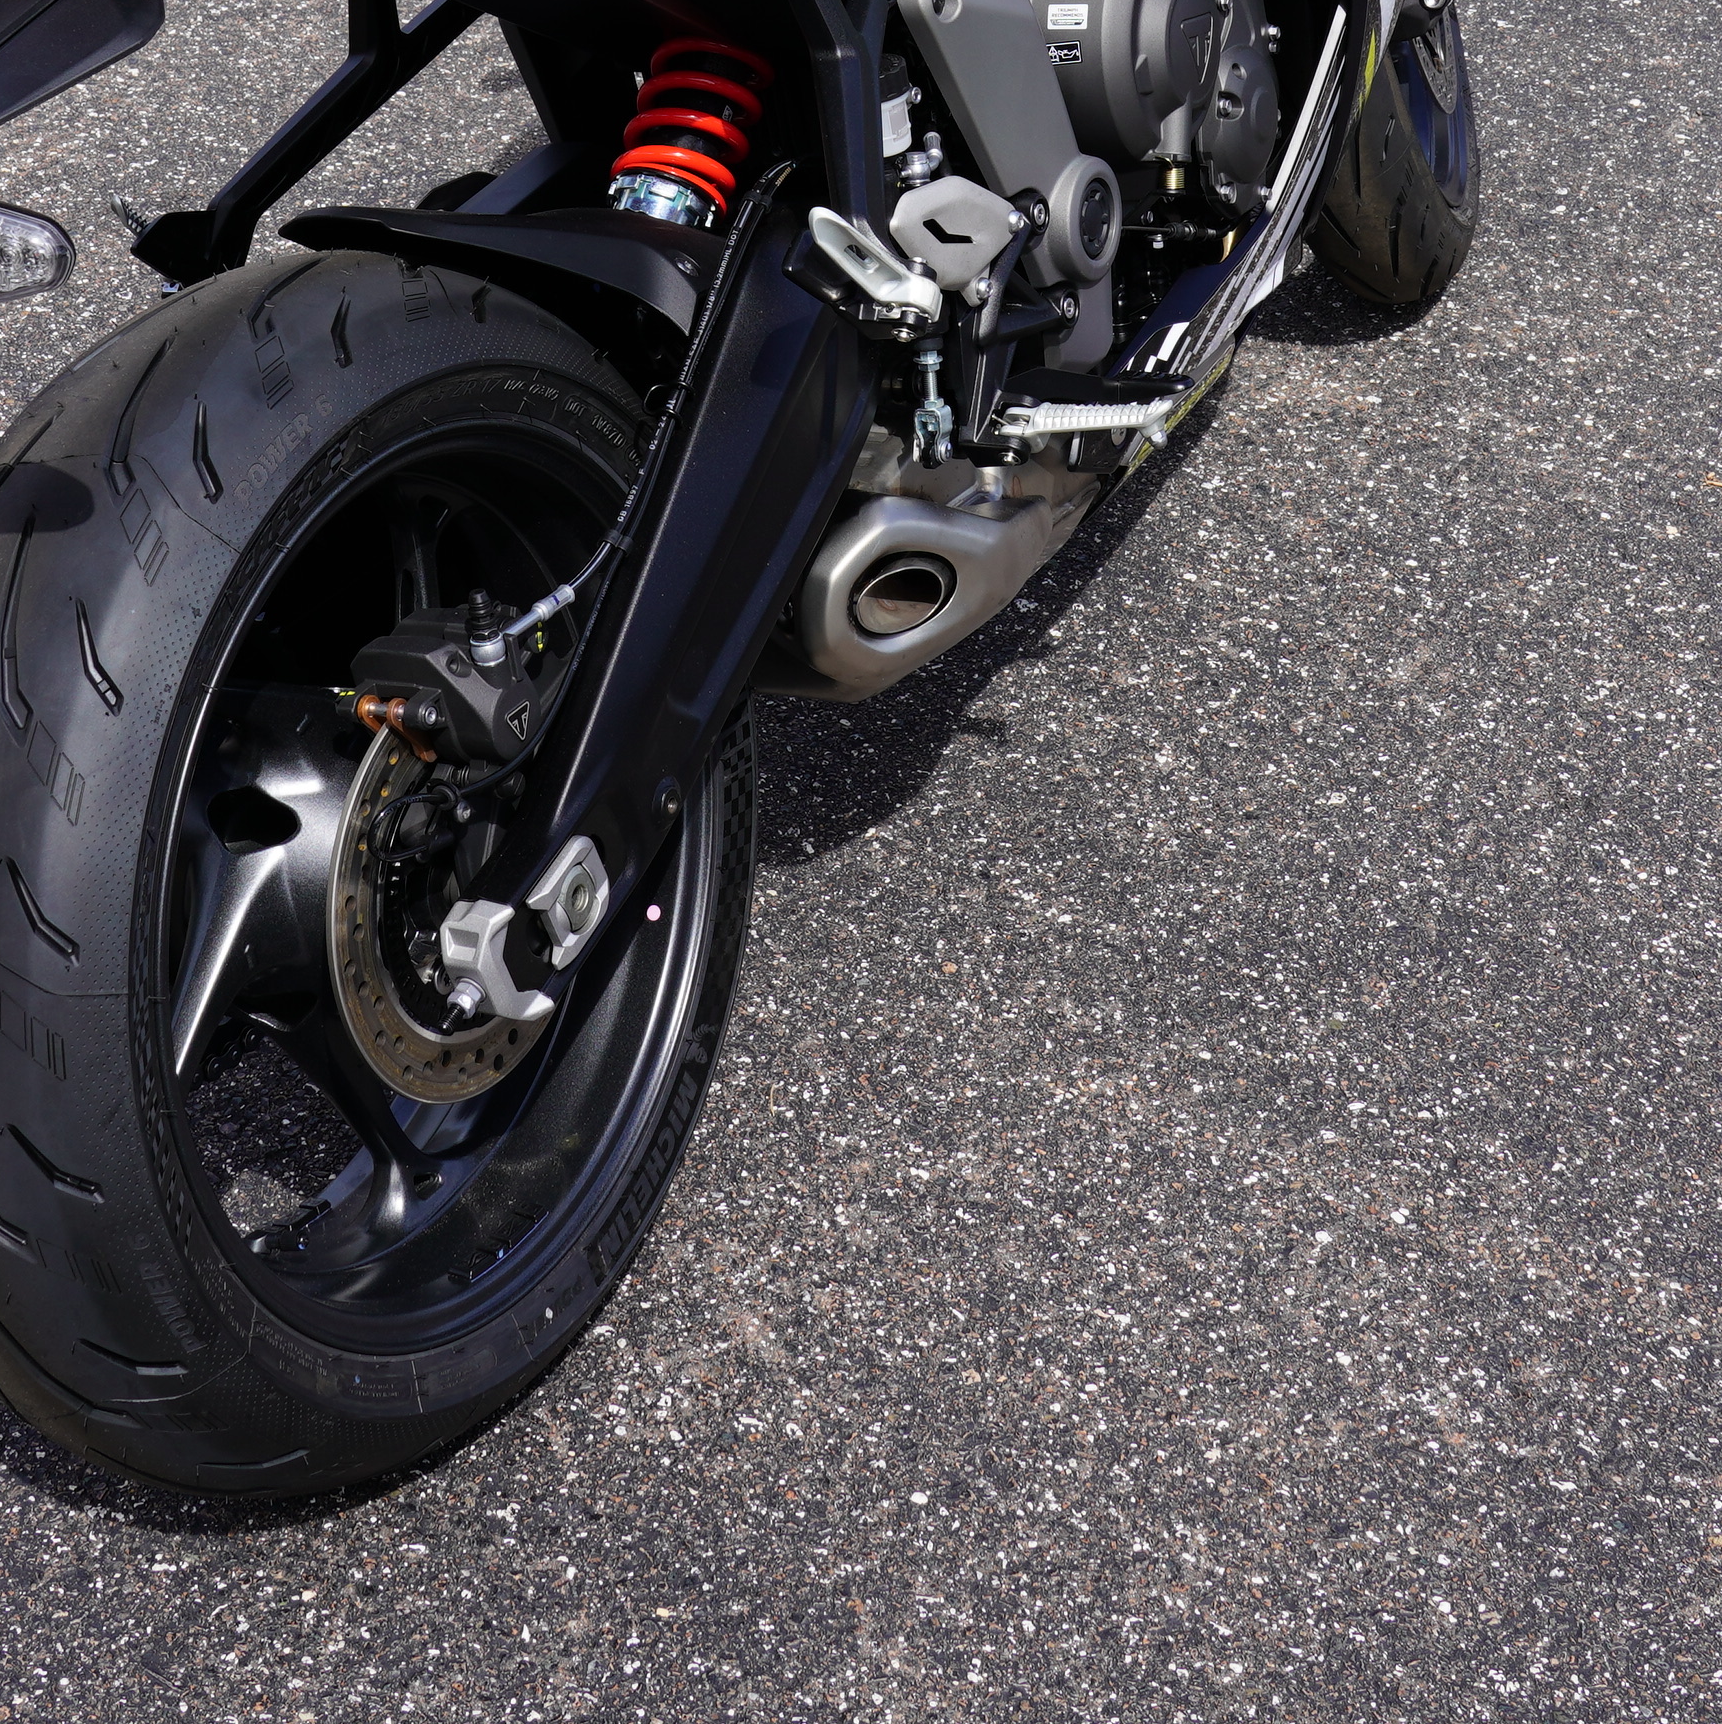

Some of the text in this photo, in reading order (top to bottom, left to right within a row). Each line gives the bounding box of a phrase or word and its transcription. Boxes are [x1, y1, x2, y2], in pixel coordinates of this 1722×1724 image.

[234, 394, 333, 509] POWER 6
[596, 1072, 698, 1269] MICHELIN
[139, 1261, 208, 1352] POWER
